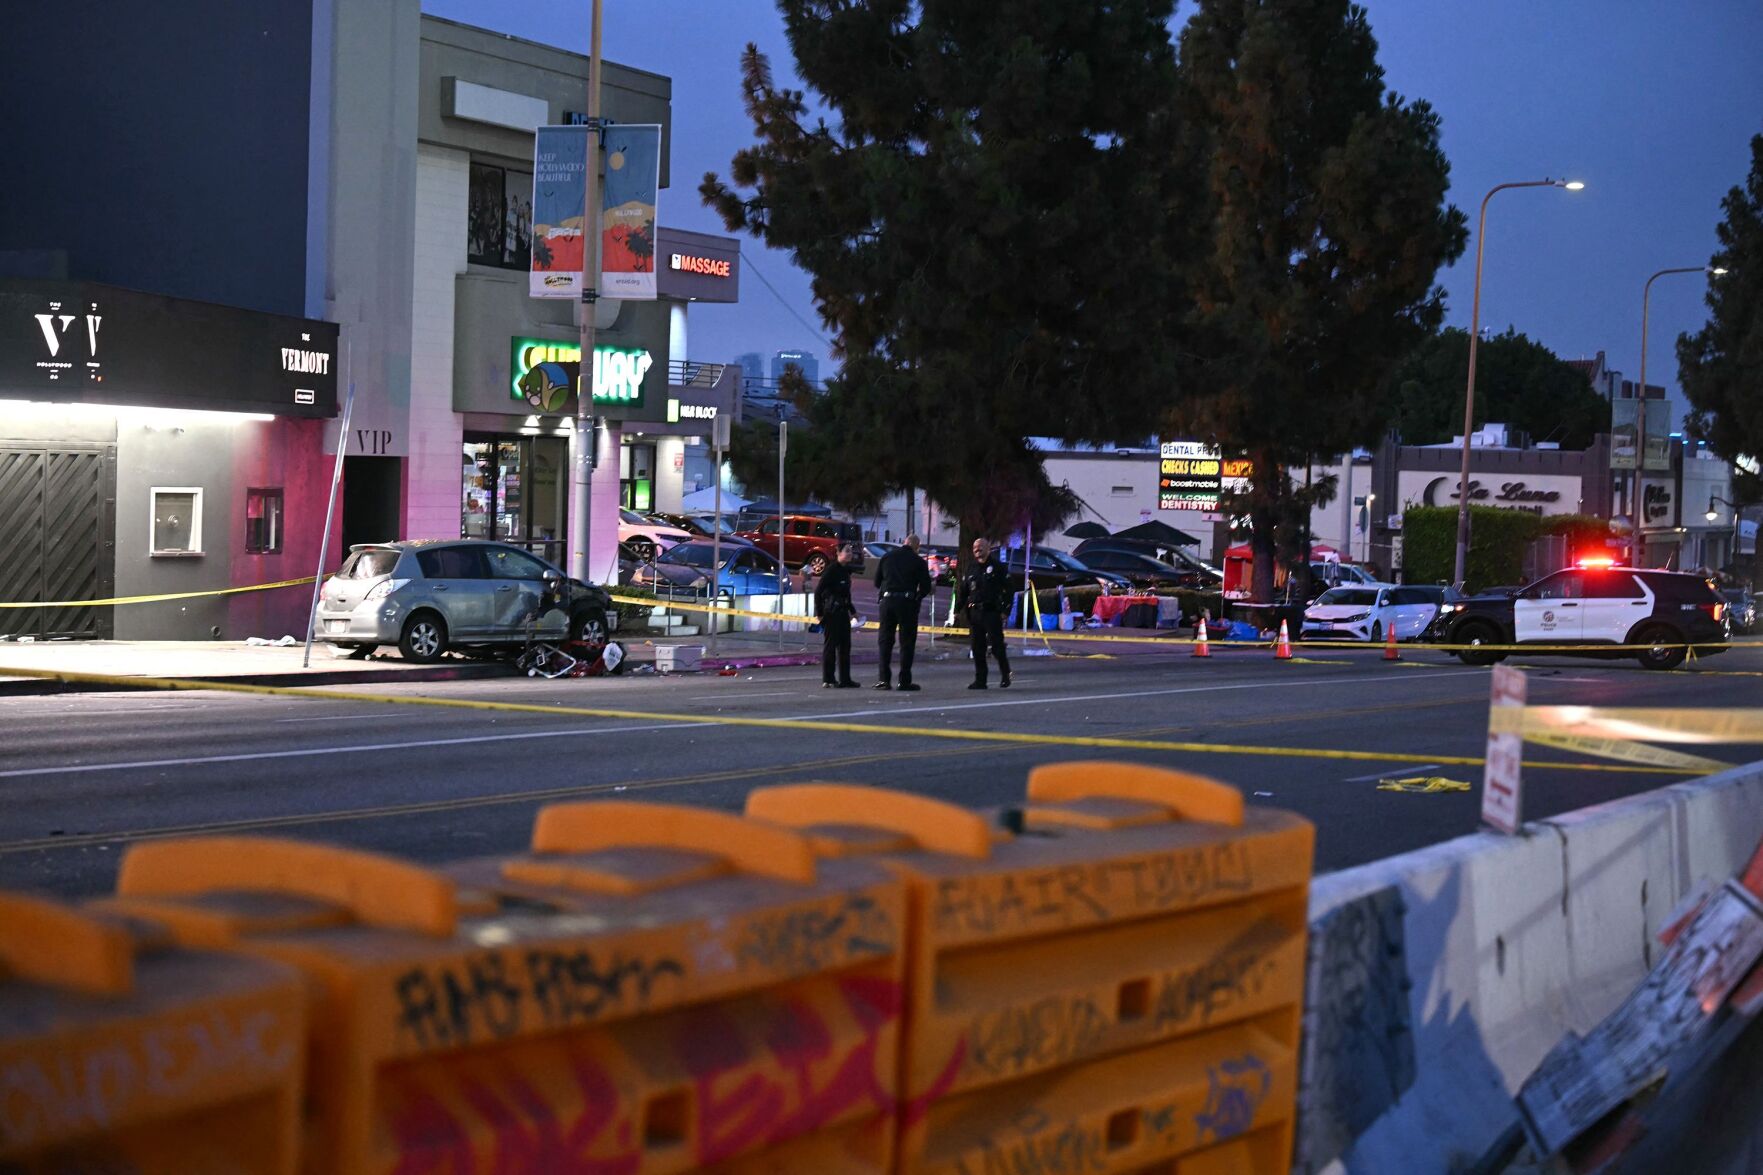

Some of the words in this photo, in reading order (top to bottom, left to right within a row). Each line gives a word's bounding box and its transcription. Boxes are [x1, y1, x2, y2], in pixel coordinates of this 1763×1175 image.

[681, 255, 730, 277] MASSAGE
[281, 347, 330, 375] VERMONT
[514, 345, 653, 399] WAY
[357, 429, 392, 454] VIP
[1163, 445, 1194, 455] DENTAL
[1161, 459, 1189, 475] CHECKS
[1190, 460, 1219, 476] CASHED
[1162, 493, 1218, 501] WELCOME
[1450, 480, 1489, 500] La
[1494, 482, 1560, 503] Luna
[1161, 500, 1218, 511] DENTISTRY
